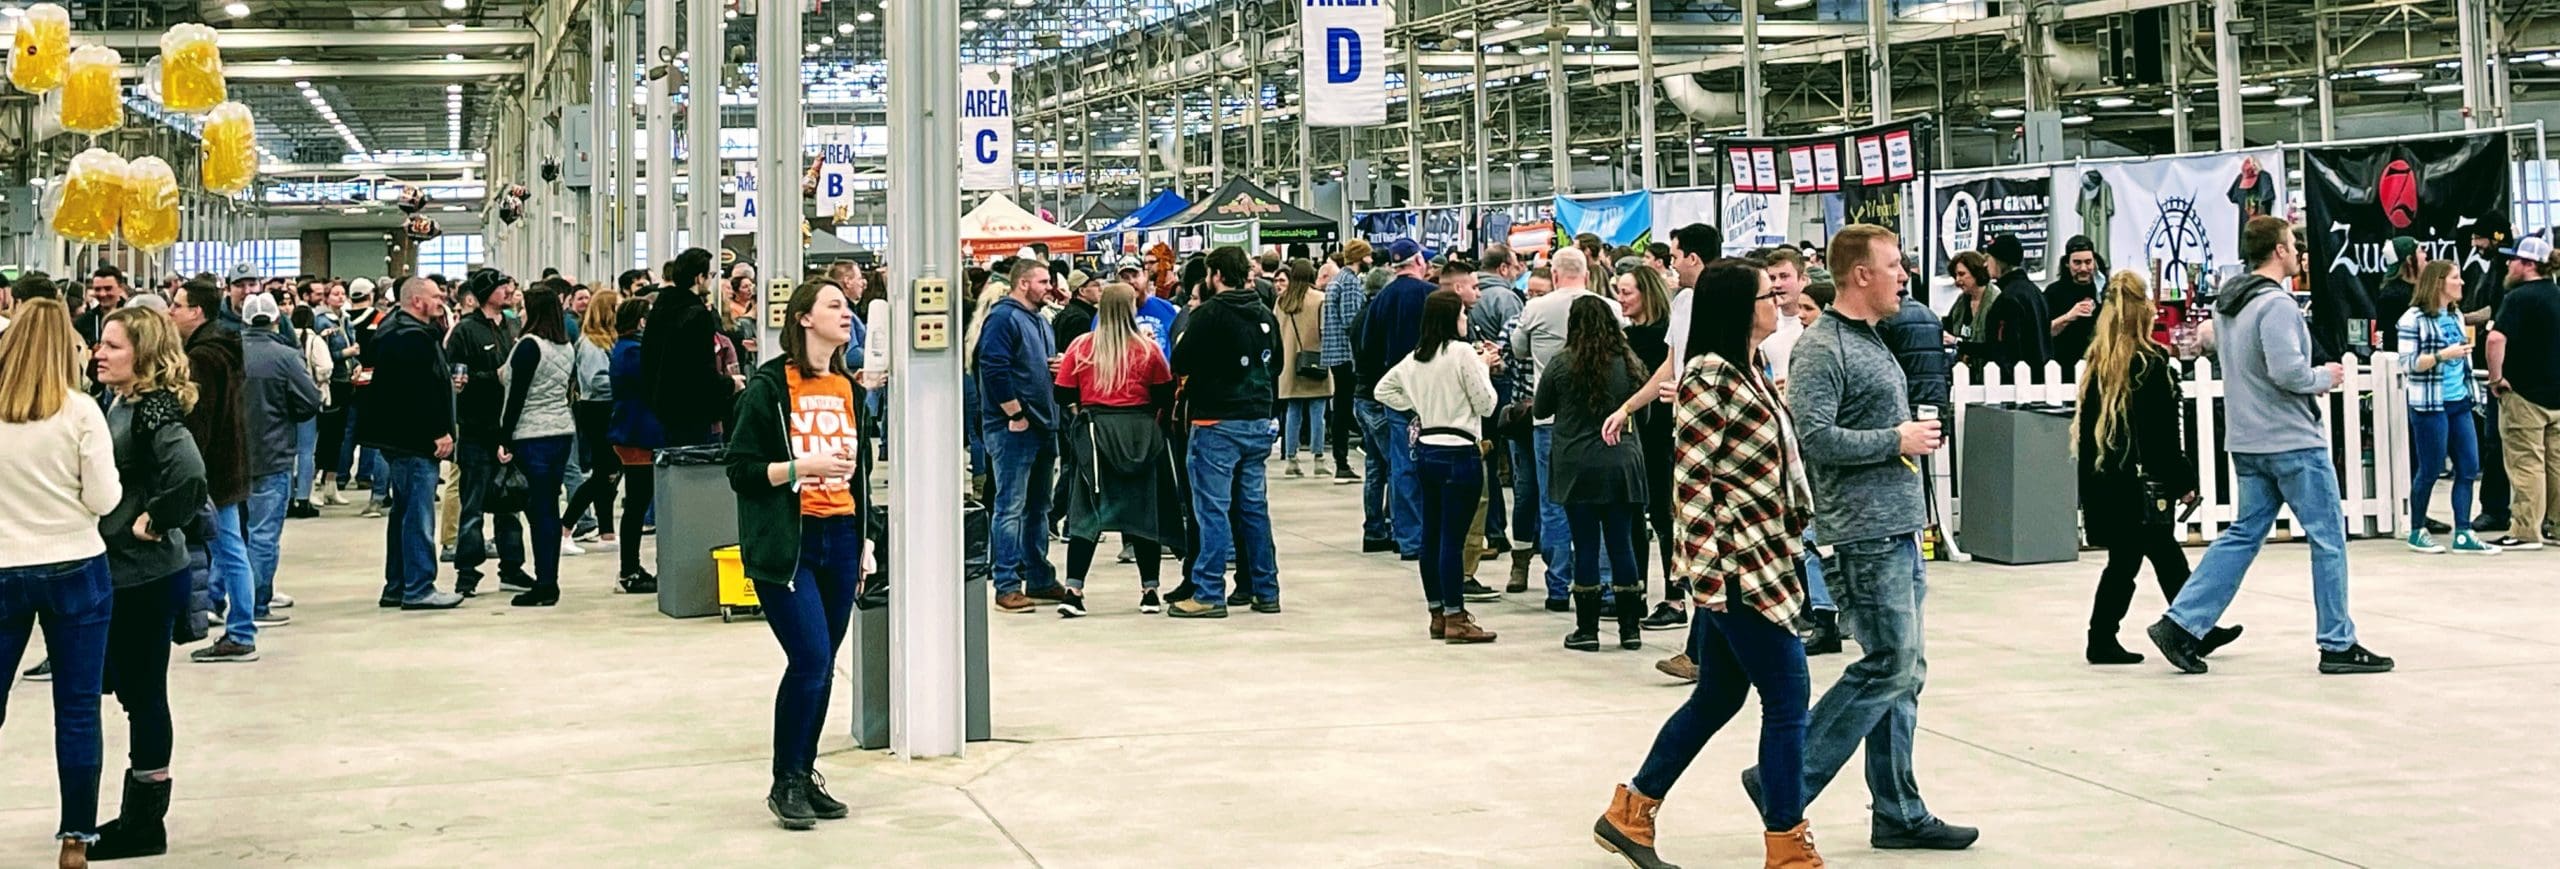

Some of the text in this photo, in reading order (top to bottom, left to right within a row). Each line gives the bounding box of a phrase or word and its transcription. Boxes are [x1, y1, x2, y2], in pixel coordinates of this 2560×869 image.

[1326, 27, 1362, 84] D
[965, 89, 1009, 118] AREA
[975, 129, 999, 164] C
[736, 175, 758, 192] ARE
[827, 173, 843, 198] B
[743, 198, 756, 217] A
[790, 410, 858, 435] VOL
